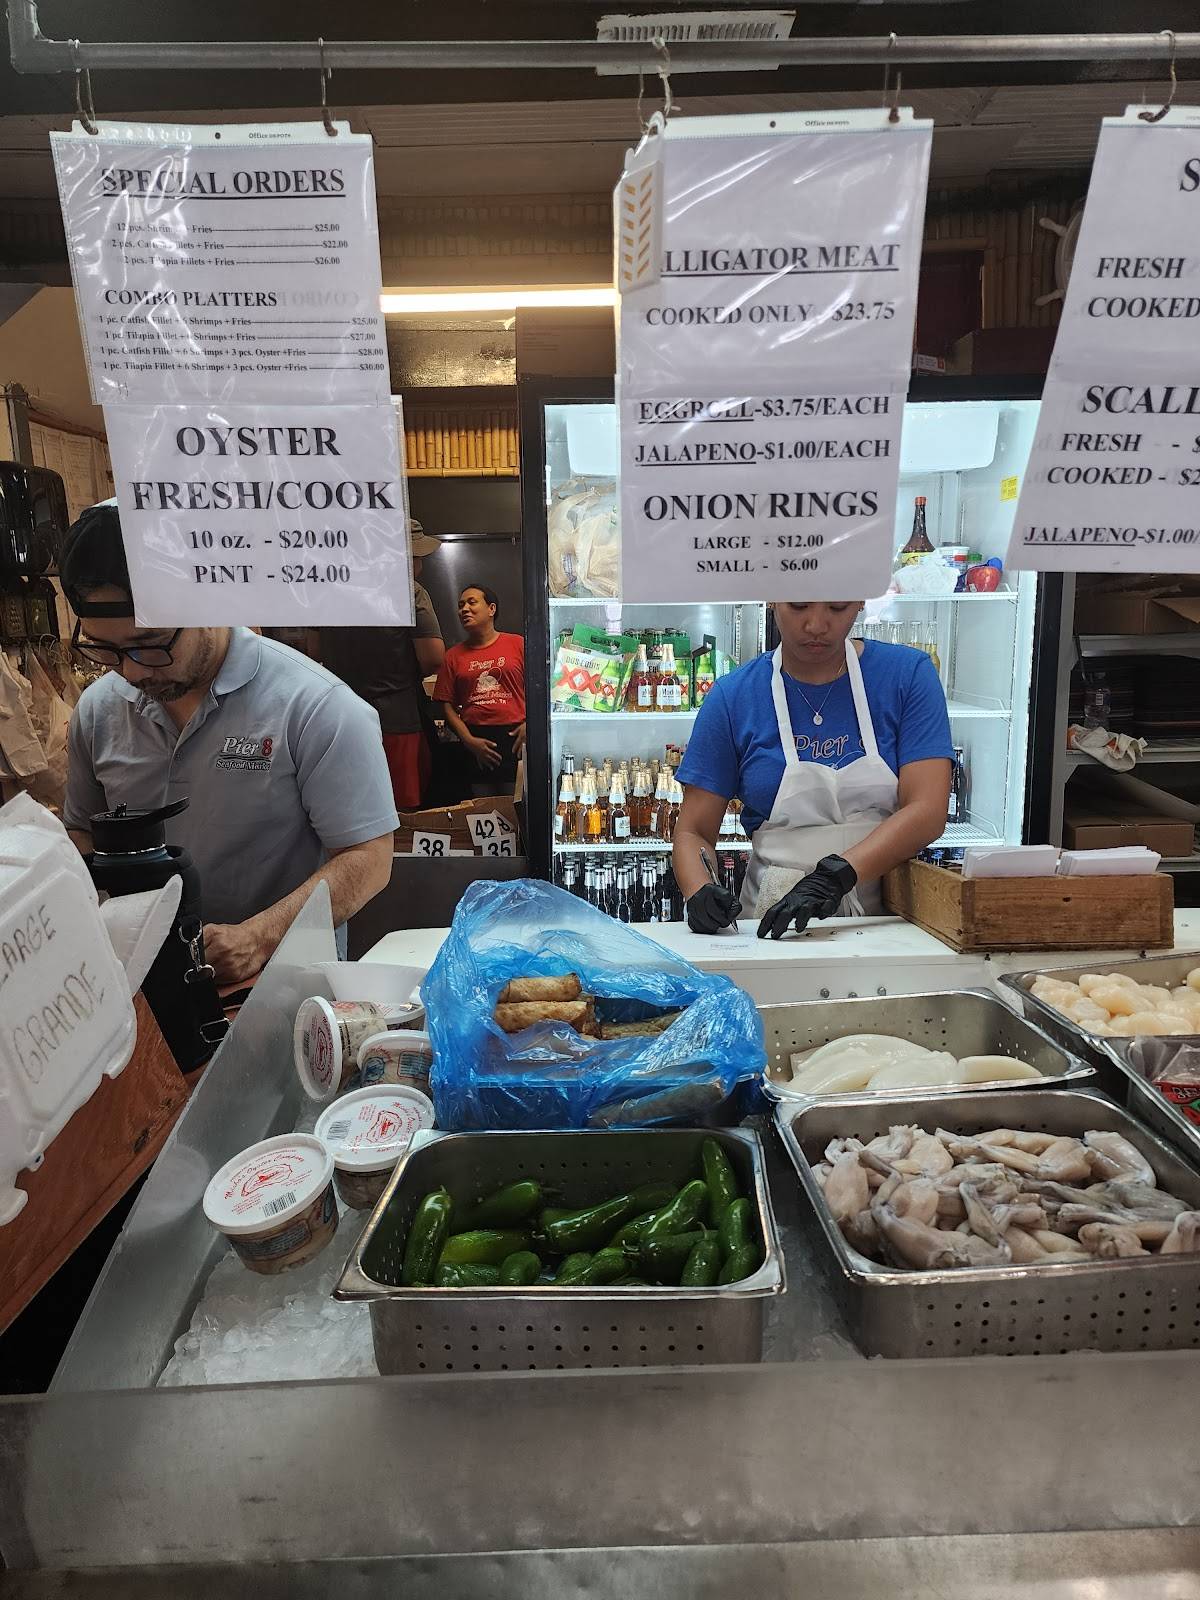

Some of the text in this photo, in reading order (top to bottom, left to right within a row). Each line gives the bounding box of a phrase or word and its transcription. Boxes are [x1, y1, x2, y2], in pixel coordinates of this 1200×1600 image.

[101, 168, 345, 194] SPECIAL ORDERS
[192, 224, 213, 233] Fries
[314, 223, 340, 232] $25.00
[204, 241, 225, 250] Fries
[322, 240, 348, 249] $22.00
[181, 257, 205, 266] Fillets
[215, 257, 235, 266] Fries
[314, 256, 341, 265] $26.00
[660, 244, 901, 273] LLIGATOR MEAT
[1096, 257, 1186, 279] FRESH
[105, 289, 277, 307] COMBO PLATTERS
[1087, 296, 1200, 318] COOKED
[120, 315, 149, 324] Catfish
[189, 316, 223, 327] Shrimps
[231, 317, 252, 326] Fries
[351, 317, 378, 325] $25.00
[646, 301, 896, 326] COOKED ONLY $23.75
[126, 331, 155, 341] Tilapia
[193, 333, 227, 342] Shrimps
[236, 333, 256, 341] Fries
[350, 333, 376, 341] $27.00
[121, 346, 151, 355] Catfish
[238, 349, 254, 358] pcs.
[255, 349, 281, 358] Oyster
[358, 348, 384, 356] $28.00
[125, 361, 153, 371] Tilapia
[155, 361, 175, 370] Fillet
[191, 362, 225, 372] Shrimps
[240, 364, 255, 372] pcs.
[256, 364, 282, 373] Oyster
[359, 364, 385, 372] $30.00
[175, 426, 342, 457] OYSTER
[635, 439, 890, 464] JALAPENO-$1.00/EACH
[1060, 433, 1143, 452] FRESH
[1047, 466, 1153, 485] COOKED
[128, 480, 395, 511] FRESH/COOK
[643, 490, 879, 522] ONION RINGS
[188, 530, 213, 550] 10
[221, 533, 251, 550] oz.
[279, 529, 348, 551] $20.00
[693, 536, 752, 551] LARGE
[777, 534, 824, 550] $12.00
[282, 564, 351, 585] $24.00
[696, 560, 754, 573] SMALL
[780, 558, 818, 573] $6.00
[221, 736, 273, 757] Pier 8
[793, 734, 849, 760] Pier
[475, 819, 498, 839] 42
[418, 837, 445, 857] 38
[487, 839, 512, 857] 35
[12, 961, 106, 1085] GRANDE
